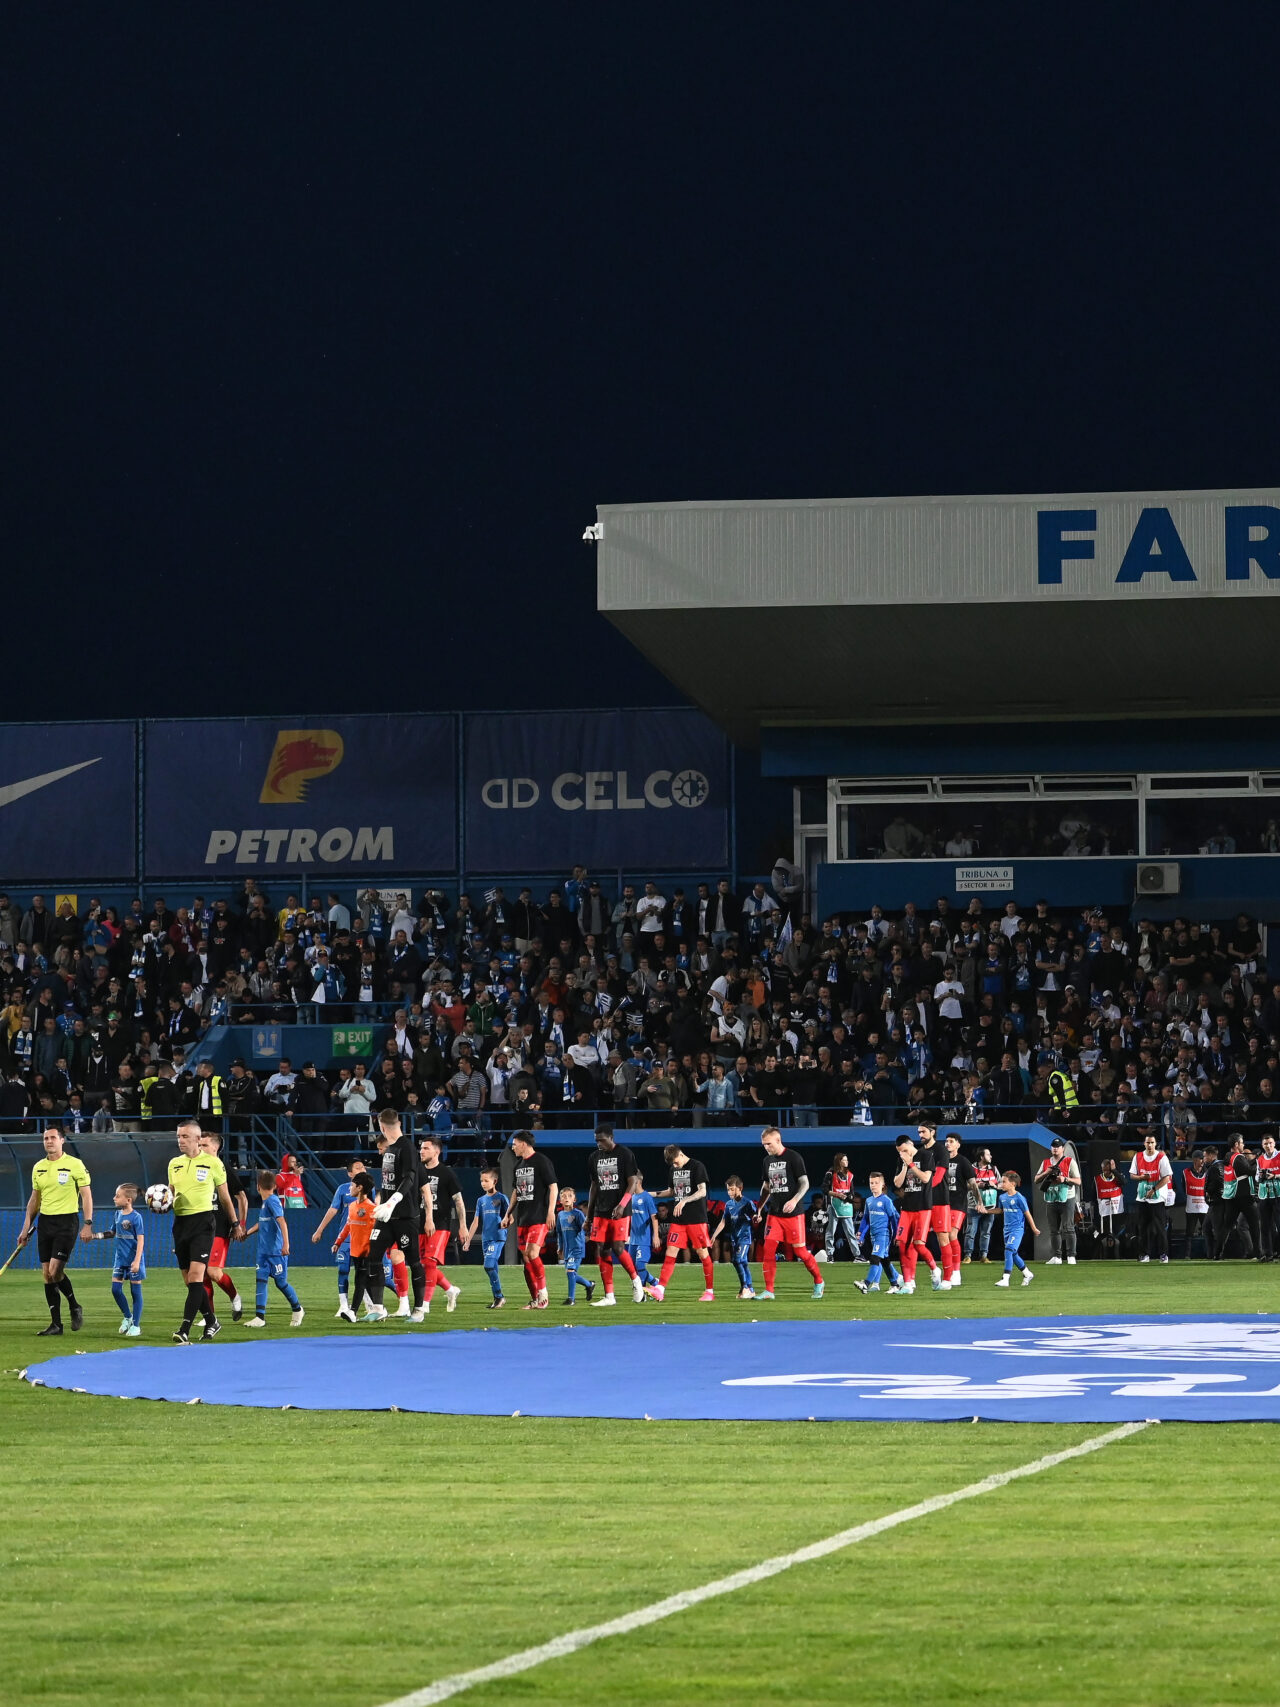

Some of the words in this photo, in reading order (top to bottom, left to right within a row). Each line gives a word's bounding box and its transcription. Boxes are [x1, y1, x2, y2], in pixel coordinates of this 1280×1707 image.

[205, 826, 394, 865] PETROM
[348, 1031, 371, 1042] EXIT
[275, 1264, 283, 1274] 10
[720, 1372, 1248, 1386] GO
